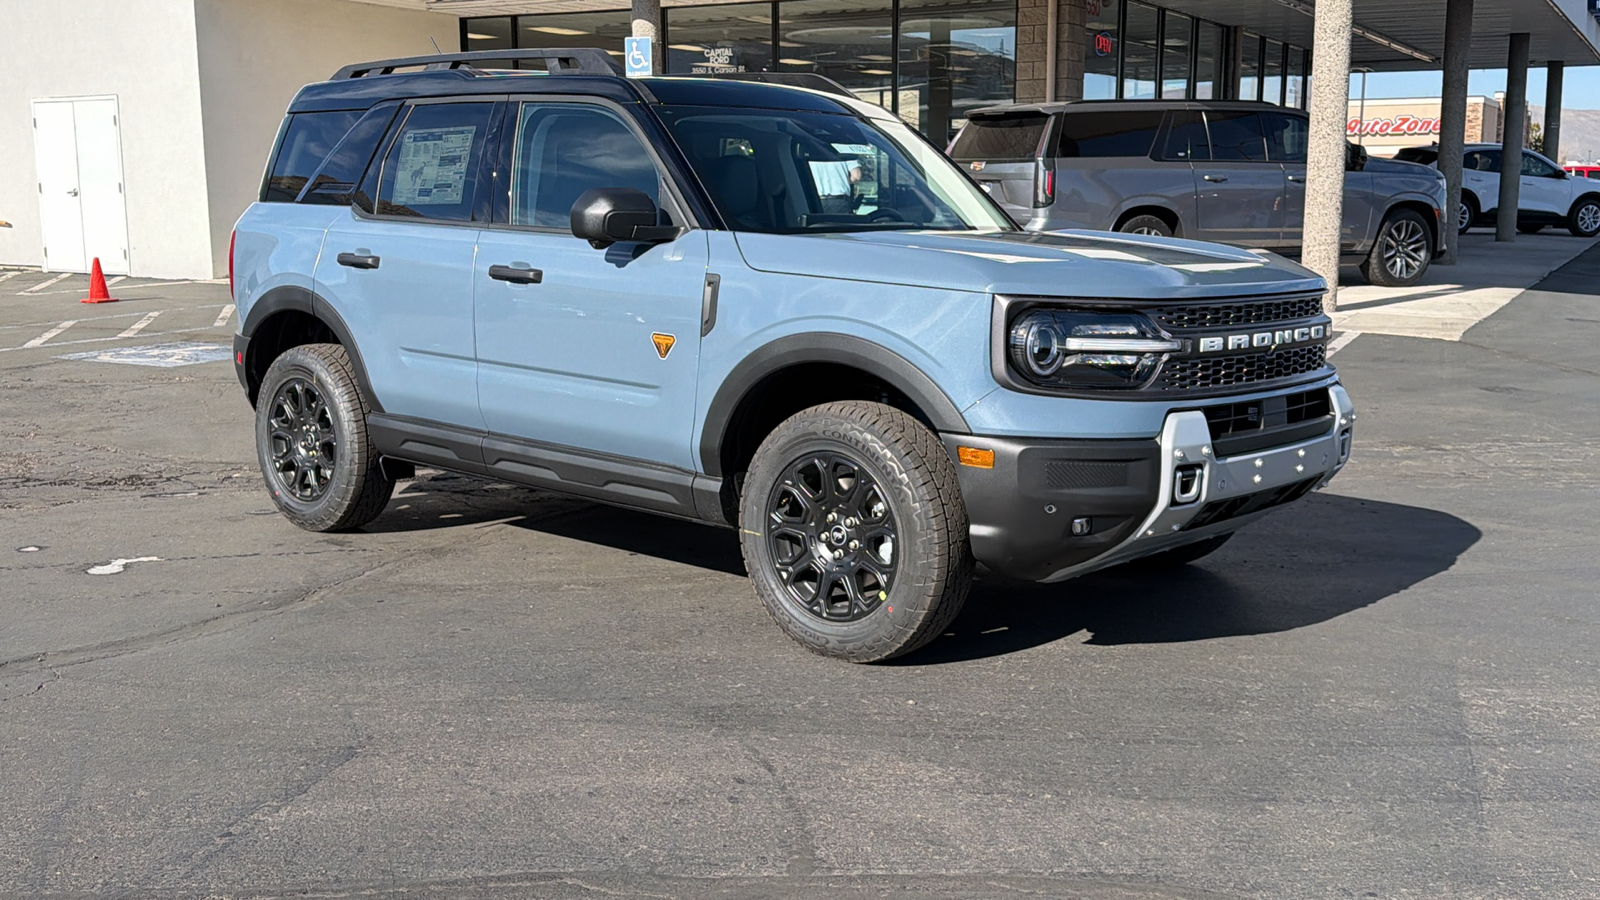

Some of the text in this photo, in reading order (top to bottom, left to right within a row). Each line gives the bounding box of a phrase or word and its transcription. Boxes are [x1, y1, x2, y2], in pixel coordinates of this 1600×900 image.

[1095, 34, 1112, 53] OPEN
[704, 48, 733, 57] CAPITAL
[710, 56, 730, 64] FORD
[714, 66, 737, 74] Carson
[1200, 325, 1324, 353] BRONCO
